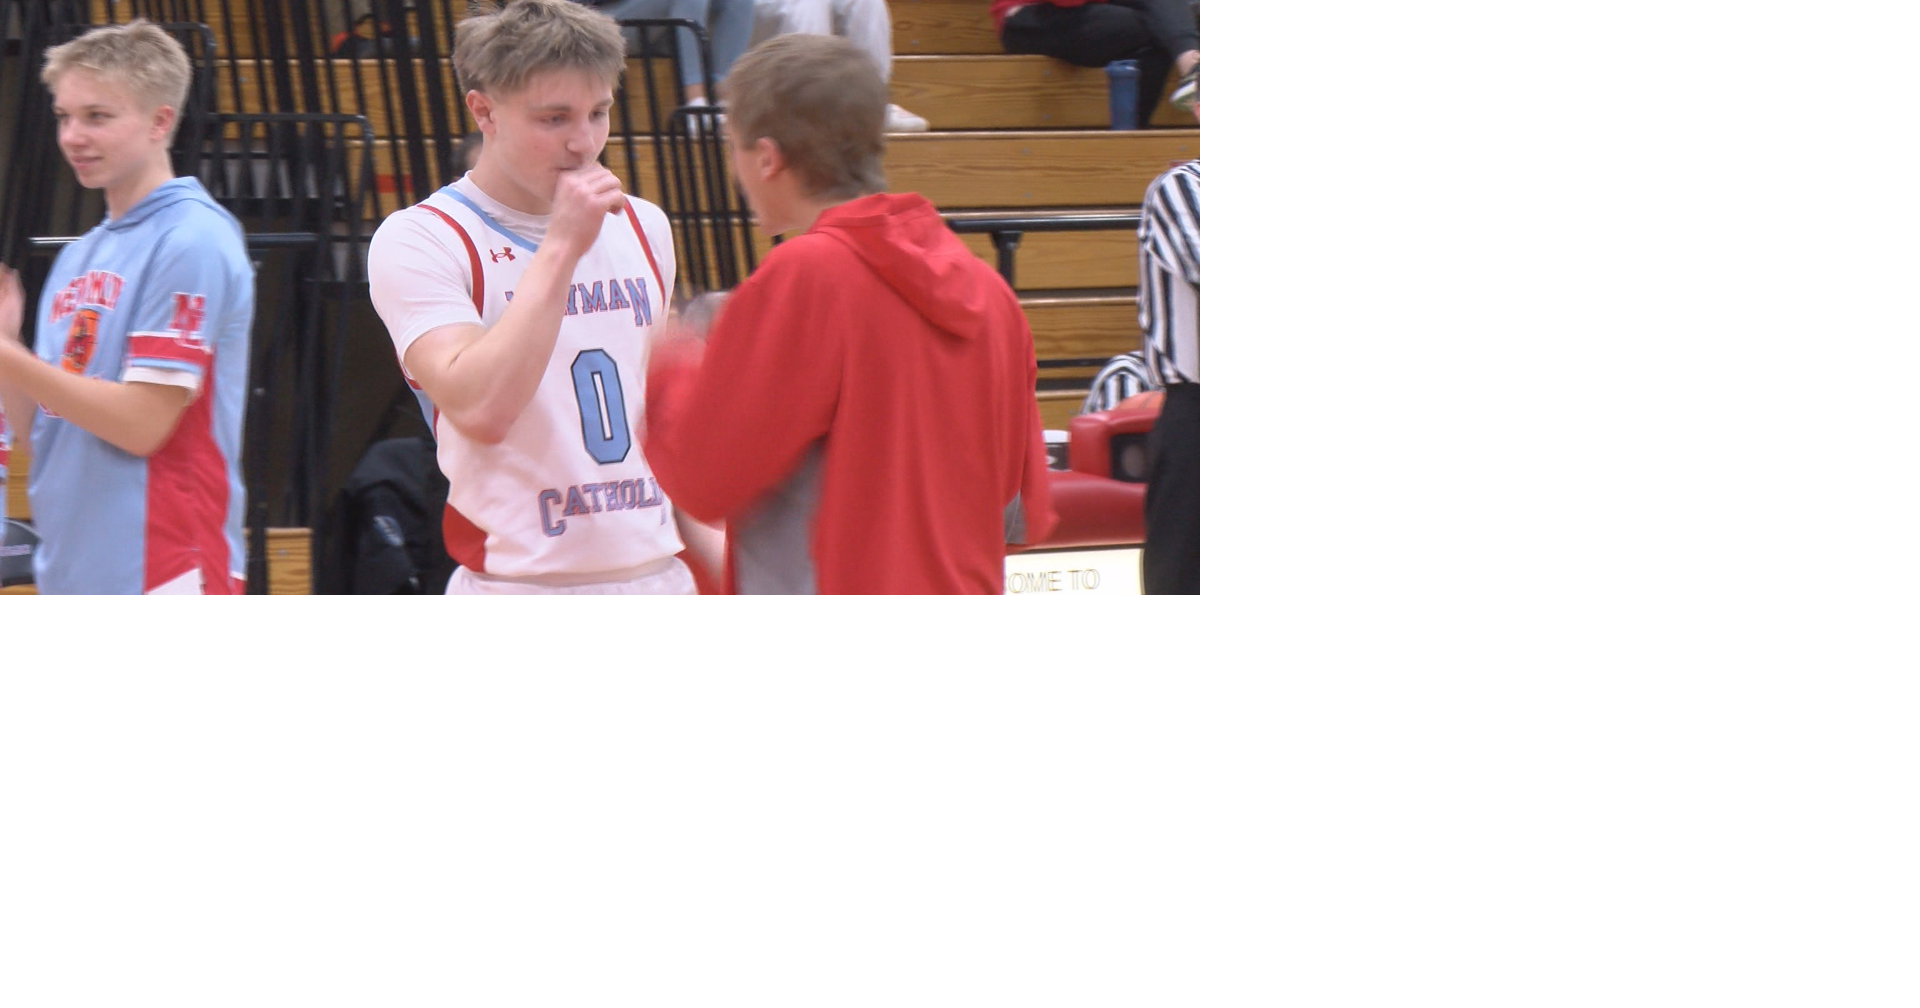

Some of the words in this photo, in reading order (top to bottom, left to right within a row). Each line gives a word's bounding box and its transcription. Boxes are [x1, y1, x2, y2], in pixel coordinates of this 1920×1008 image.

[571, 348, 632, 466] 0
[537, 476, 667, 538] CATHOLI
[1008, 570, 1063, 594] OME
[1067, 568, 1101, 591] TO
